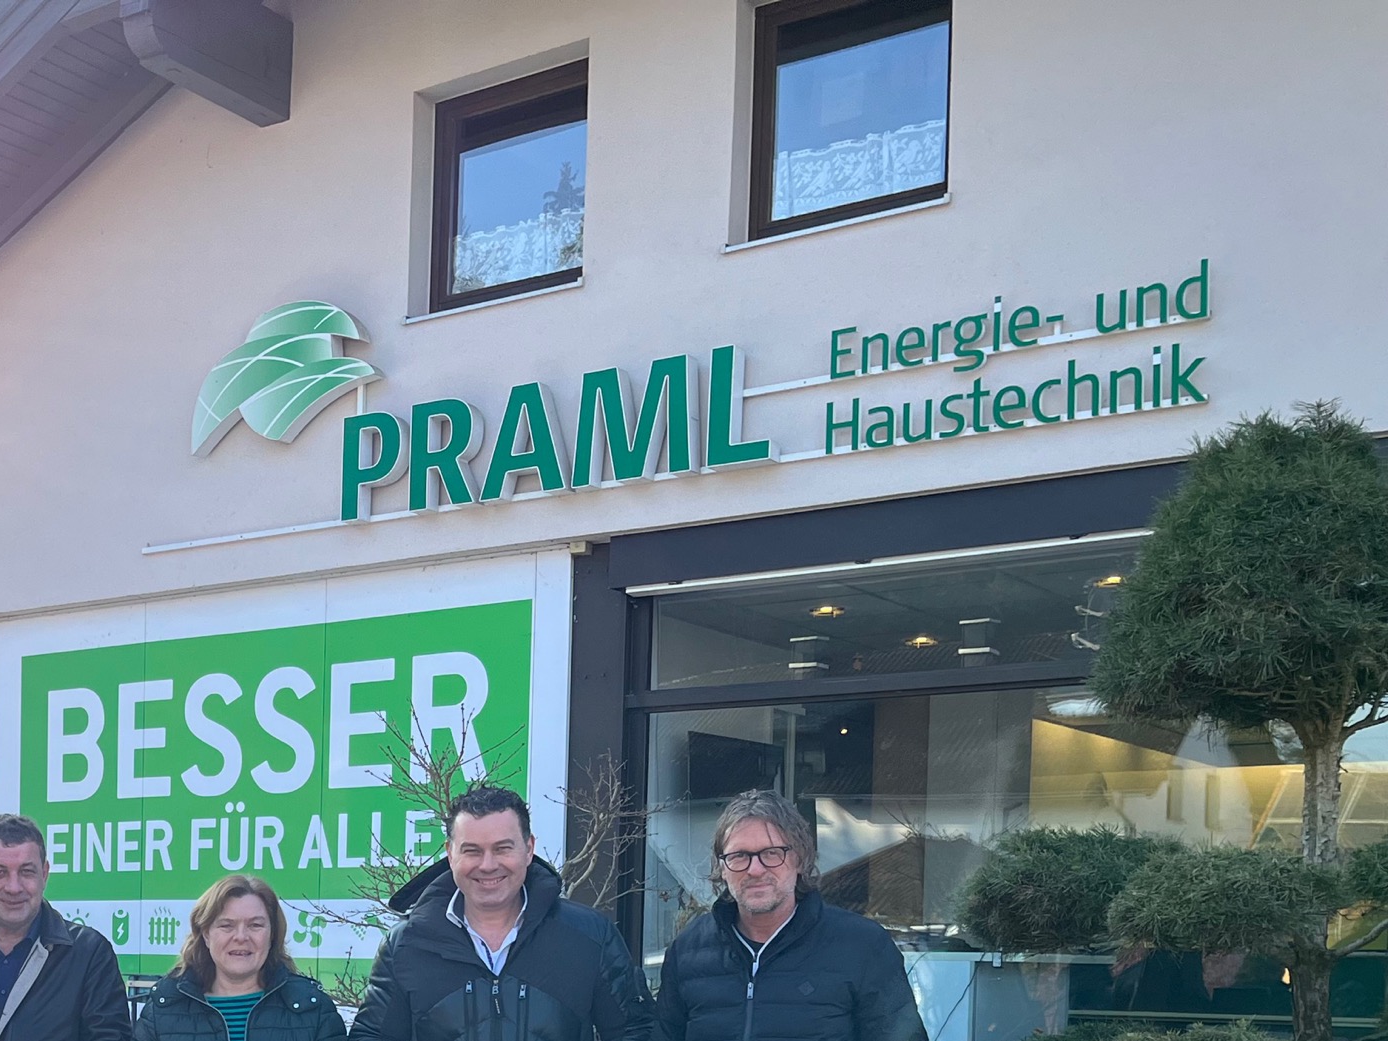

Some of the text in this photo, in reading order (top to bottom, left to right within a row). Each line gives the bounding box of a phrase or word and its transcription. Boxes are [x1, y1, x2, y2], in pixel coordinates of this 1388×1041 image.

[830, 259, 1210, 379] Energie- und
[340, 344, 774, 523] PRAML
[825, 343, 1208, 455] Haustechnik
[46, 651, 491, 803] BESSER
[46, 800, 448, 874] EINER FÜR ALLE
